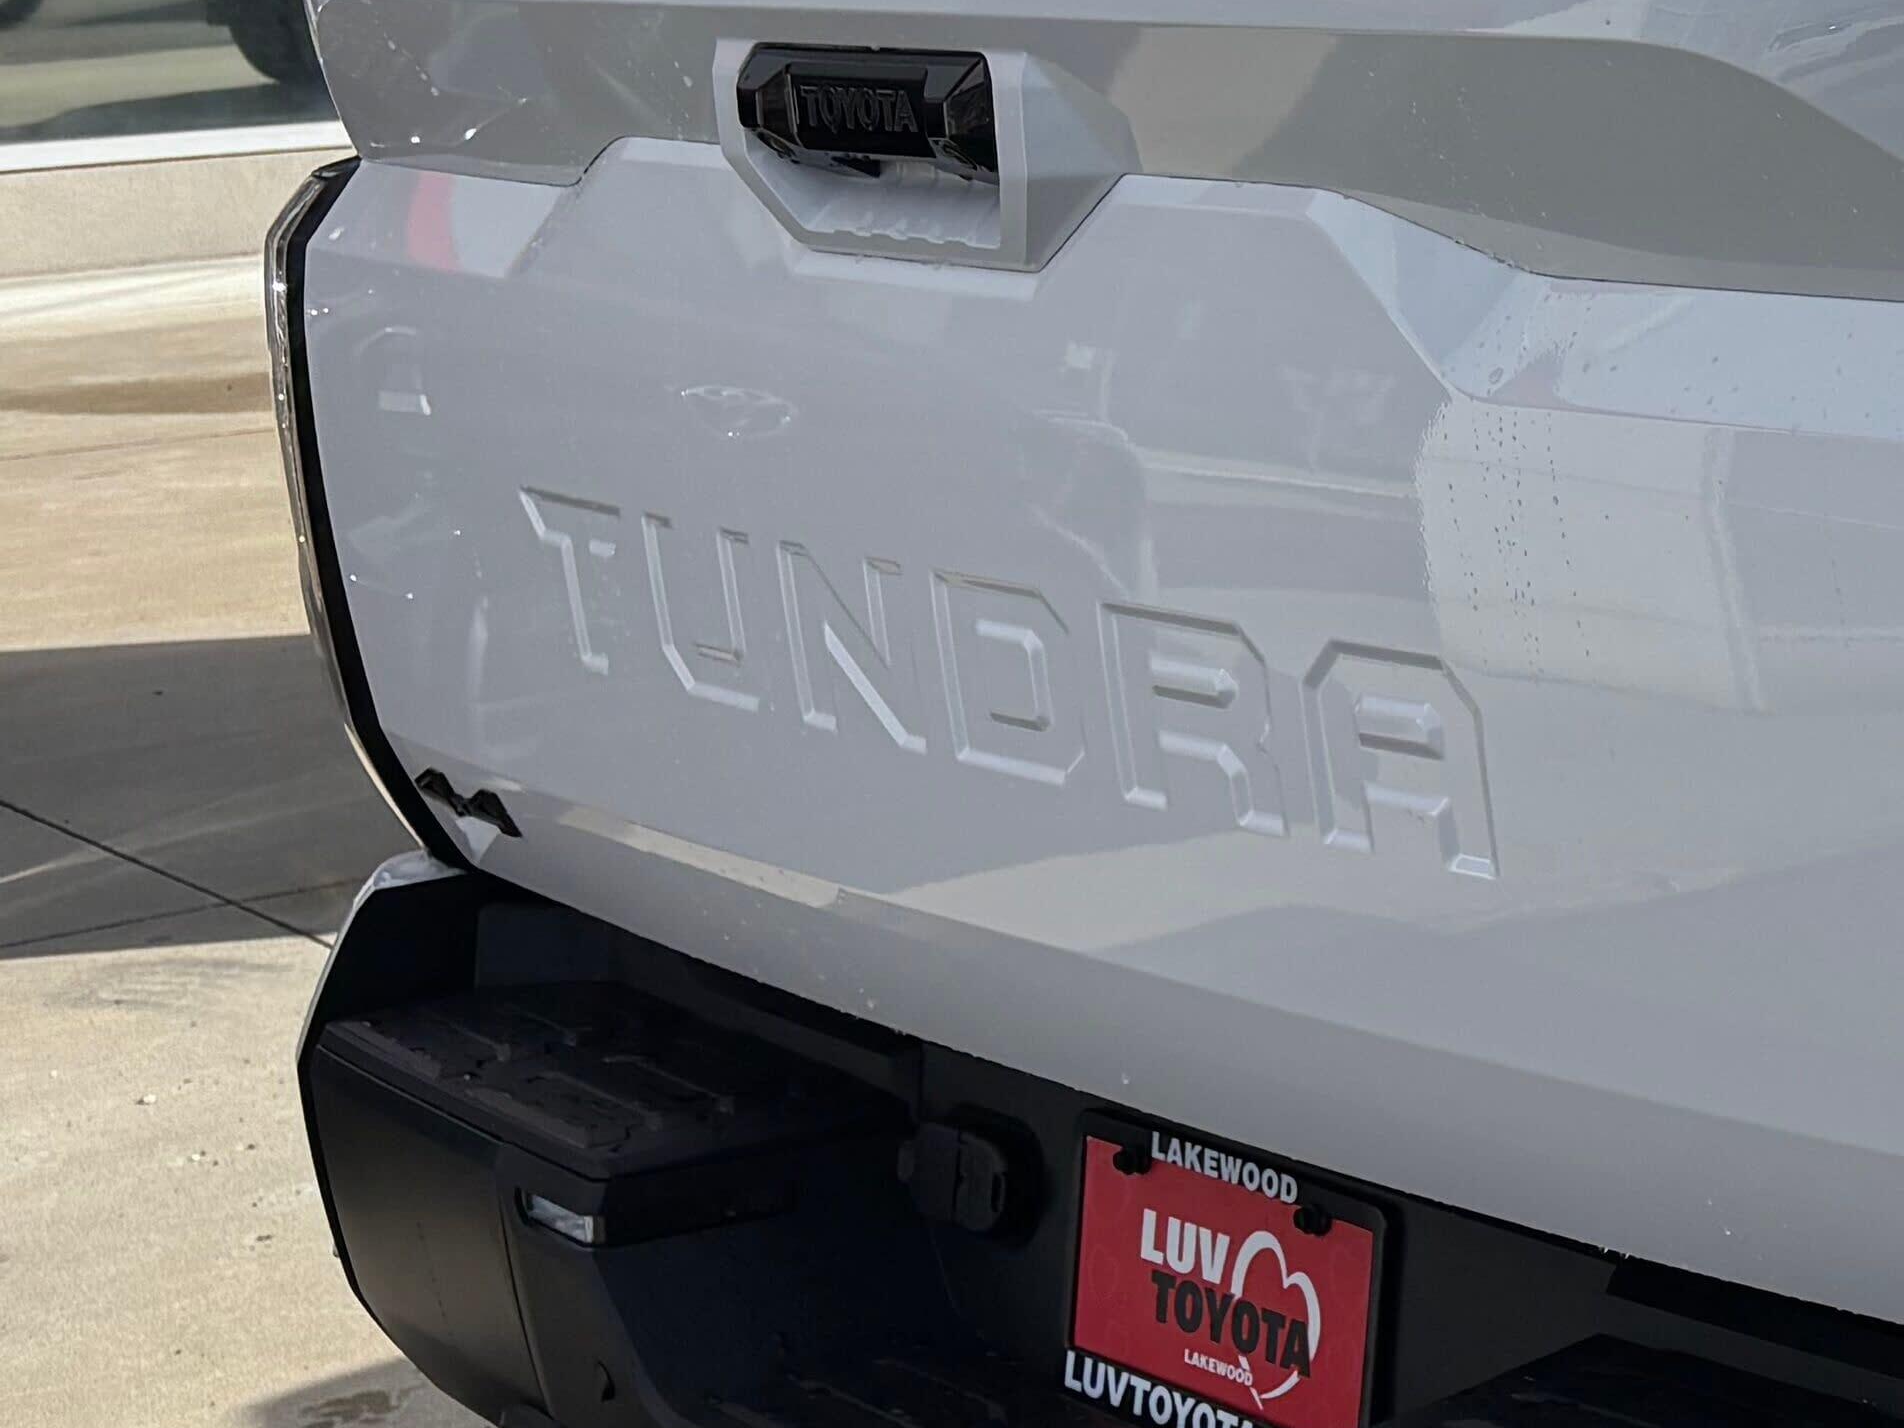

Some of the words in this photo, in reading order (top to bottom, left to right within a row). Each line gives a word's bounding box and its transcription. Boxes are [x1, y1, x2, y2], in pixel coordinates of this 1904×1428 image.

[799, 83, 920, 134] TOYOTA
[517, 483, 1501, 880] TUNDRA
[1151, 1131, 1298, 1204] LAKEWOOD
[1140, 1208, 1231, 1285] LUV
[1150, 1269, 1311, 1377] TOYOTA
[1184, 1348, 1253, 1387] LAKEWOOD
